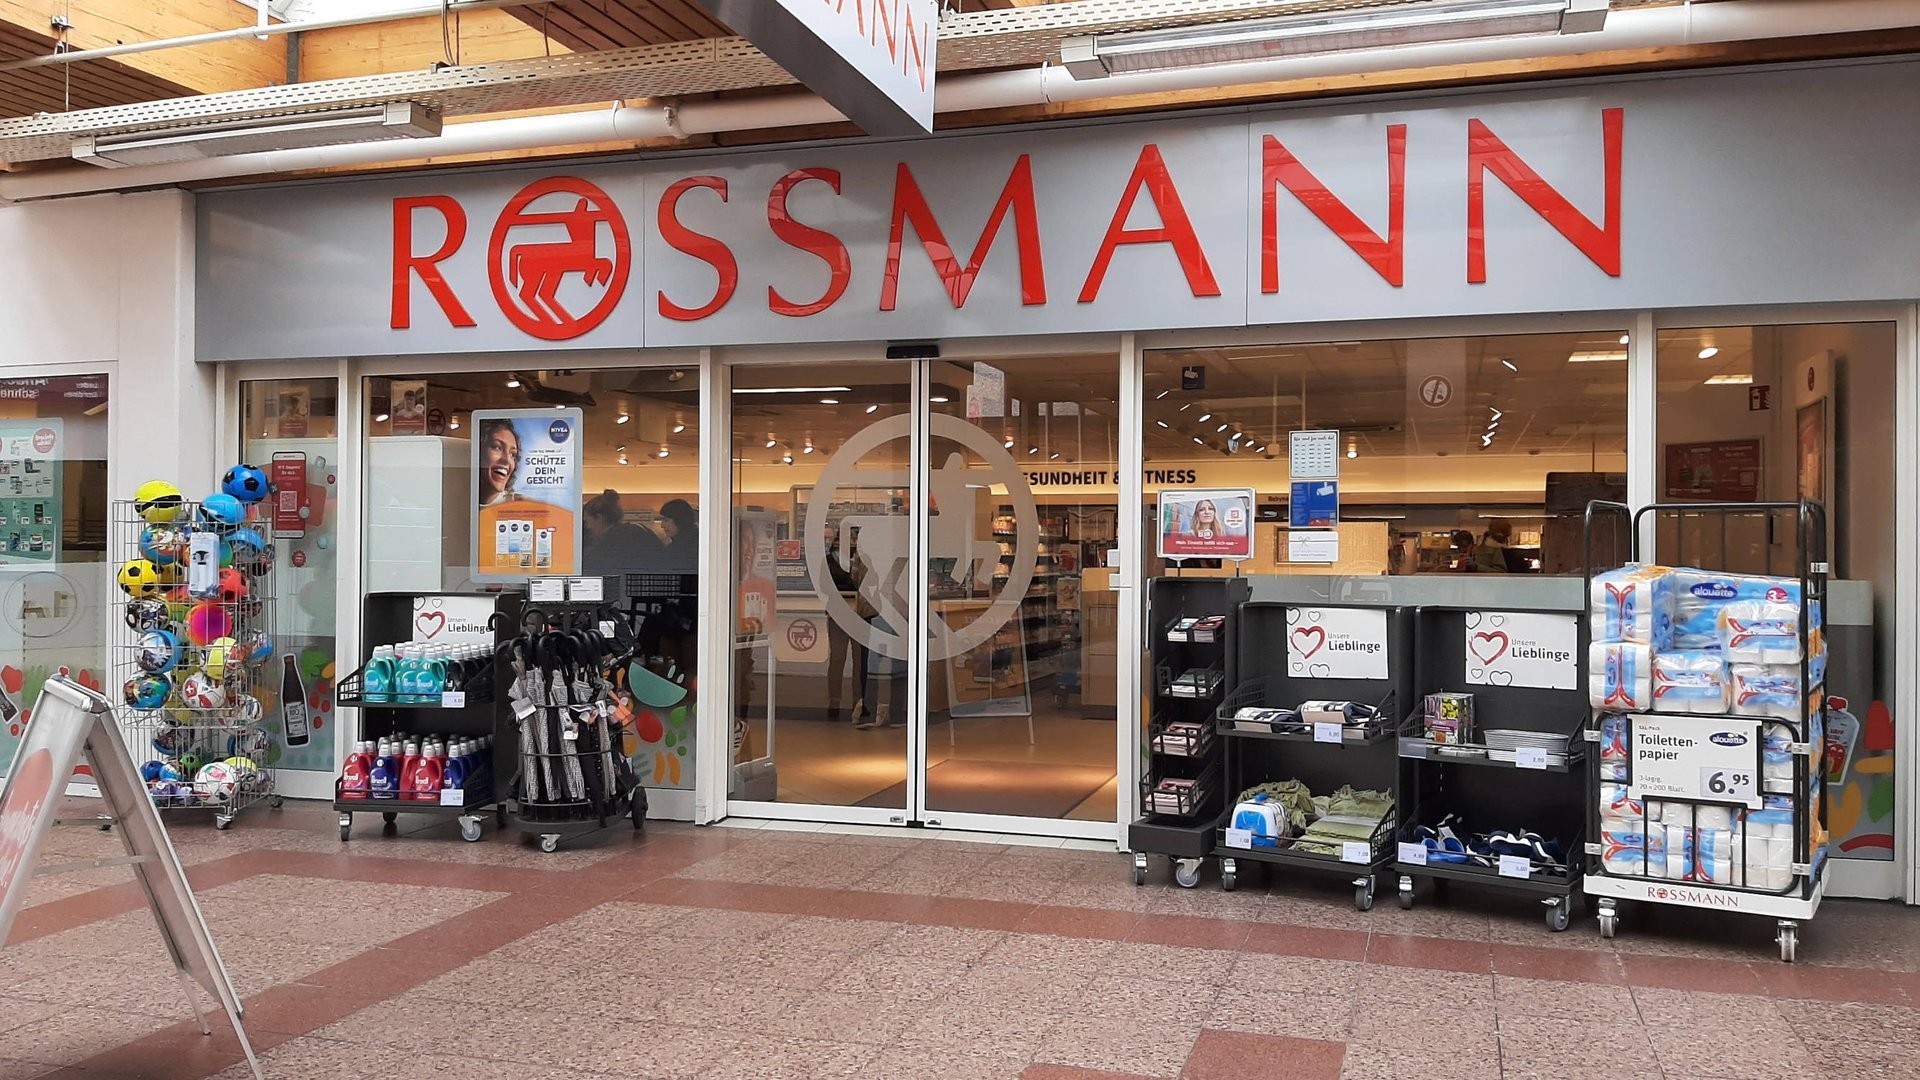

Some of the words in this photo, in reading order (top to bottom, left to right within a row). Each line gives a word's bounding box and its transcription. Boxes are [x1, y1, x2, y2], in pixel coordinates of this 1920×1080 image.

[390, 107, 1624, 340] ROSSMANN
[525, 455, 566, 465] SCHÜTZE
[535, 467, 556, 475] DEIN
[526, 476, 564, 485] GESICHT
[1023, 471, 1107, 486] SUNDHEIT
[1144, 469, 1196, 484] TNESS
[1694, 585, 1734, 598] alouette
[448, 623, 491, 634] Lieblinge
[1327, 632, 1350, 640] Unsere
[1328, 640, 1381, 653] Lieblinge
[1511, 638, 1536, 647] Unsere
[1512, 647, 1570, 662] Lieblinge
[1639, 734, 1698, 747] Toiletten-
[1712, 734, 1745, 744] alouette
[1639, 749, 1679, 761] papier
[1708, 771, 1750, 794] 6.95
[1647, 886, 1739, 907] ROSSMANN
